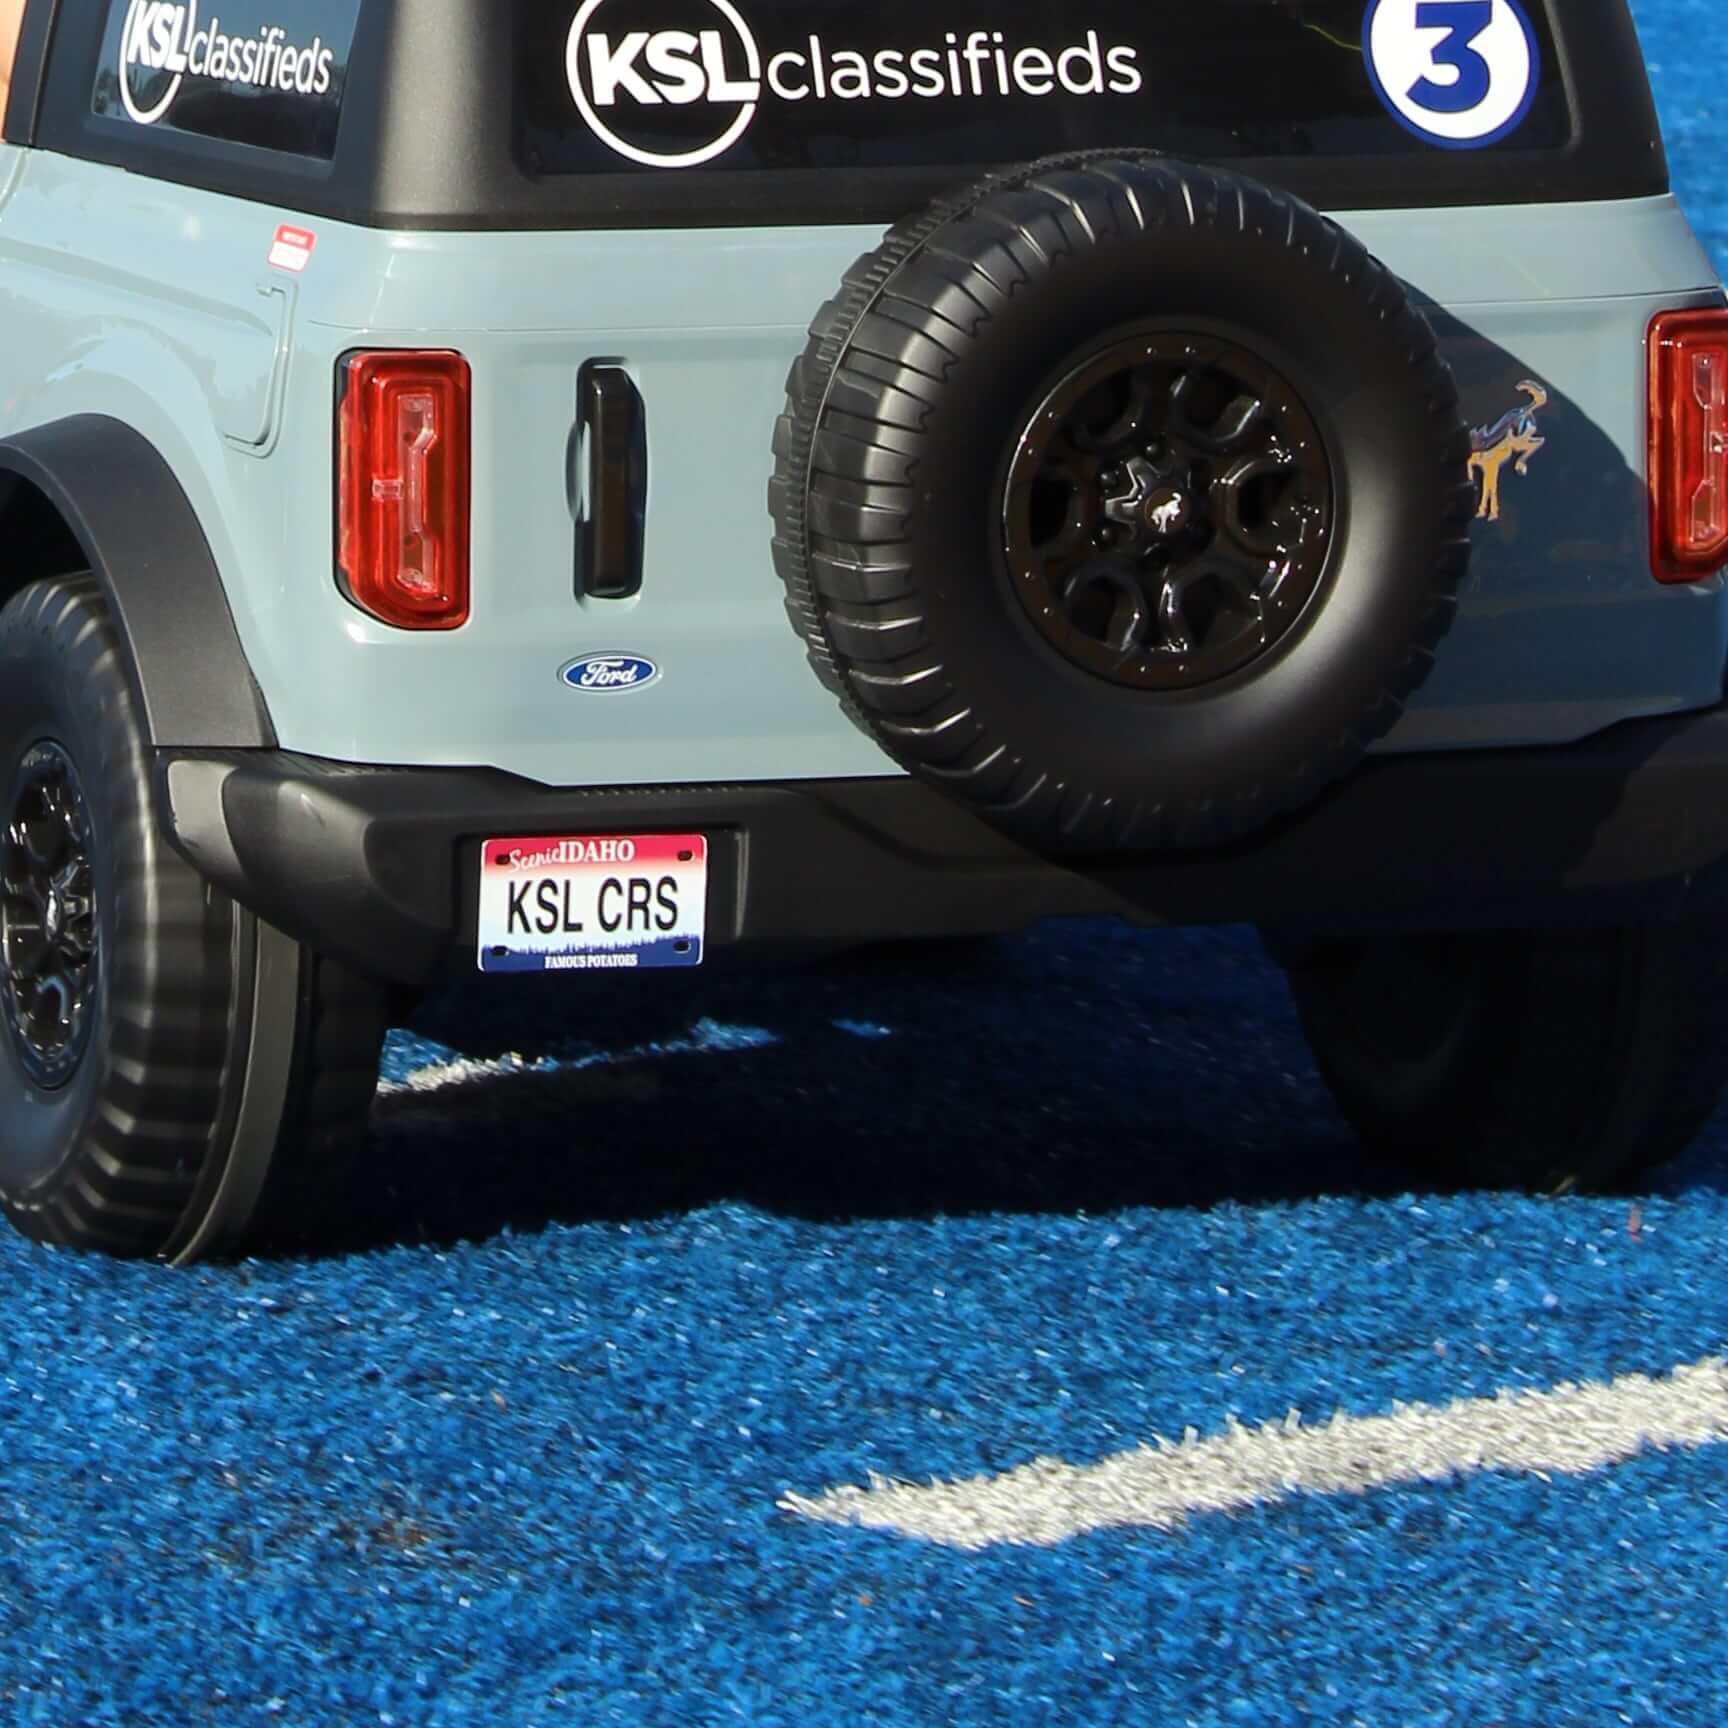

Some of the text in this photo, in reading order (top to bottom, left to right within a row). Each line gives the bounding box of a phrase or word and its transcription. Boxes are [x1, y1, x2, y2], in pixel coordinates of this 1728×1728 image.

[126, 0, 334, 93] KSL classifieds
[586, 30, 1142, 106] KSL classifieds
[1405, 0, 1493, 114] 3
[580, 660, 638, 685] Ford
[509, 840, 635, 872] Scenic IDAHO
[507, 875, 678, 934] KSL CRS
[544, 954, 638, 969] FAMOUS POTATOES
